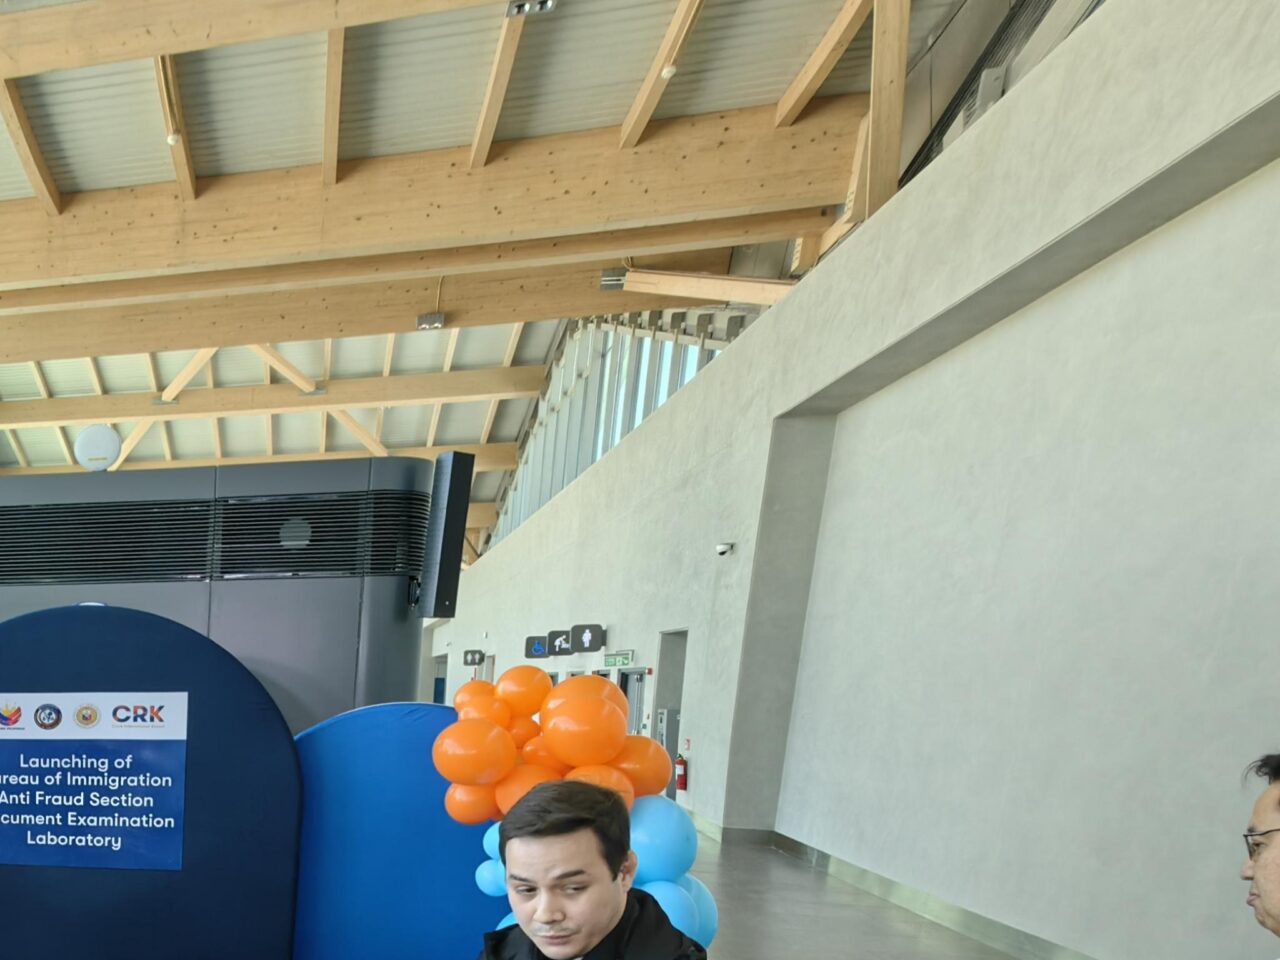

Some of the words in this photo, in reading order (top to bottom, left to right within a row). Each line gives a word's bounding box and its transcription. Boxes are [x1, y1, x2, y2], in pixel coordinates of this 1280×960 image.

[112, 705, 165, 723] CRK
[20, 754, 109, 772] Launching
[113, 754, 133, 769] of
[44, 771, 62, 785] of
[67, 772, 172, 789] Immigration
[35, 791, 84, 806] Fraud
[89, 792, 154, 807] Section
[67, 812, 175, 828] Examination
[27, 830, 121, 850] Laboratory
